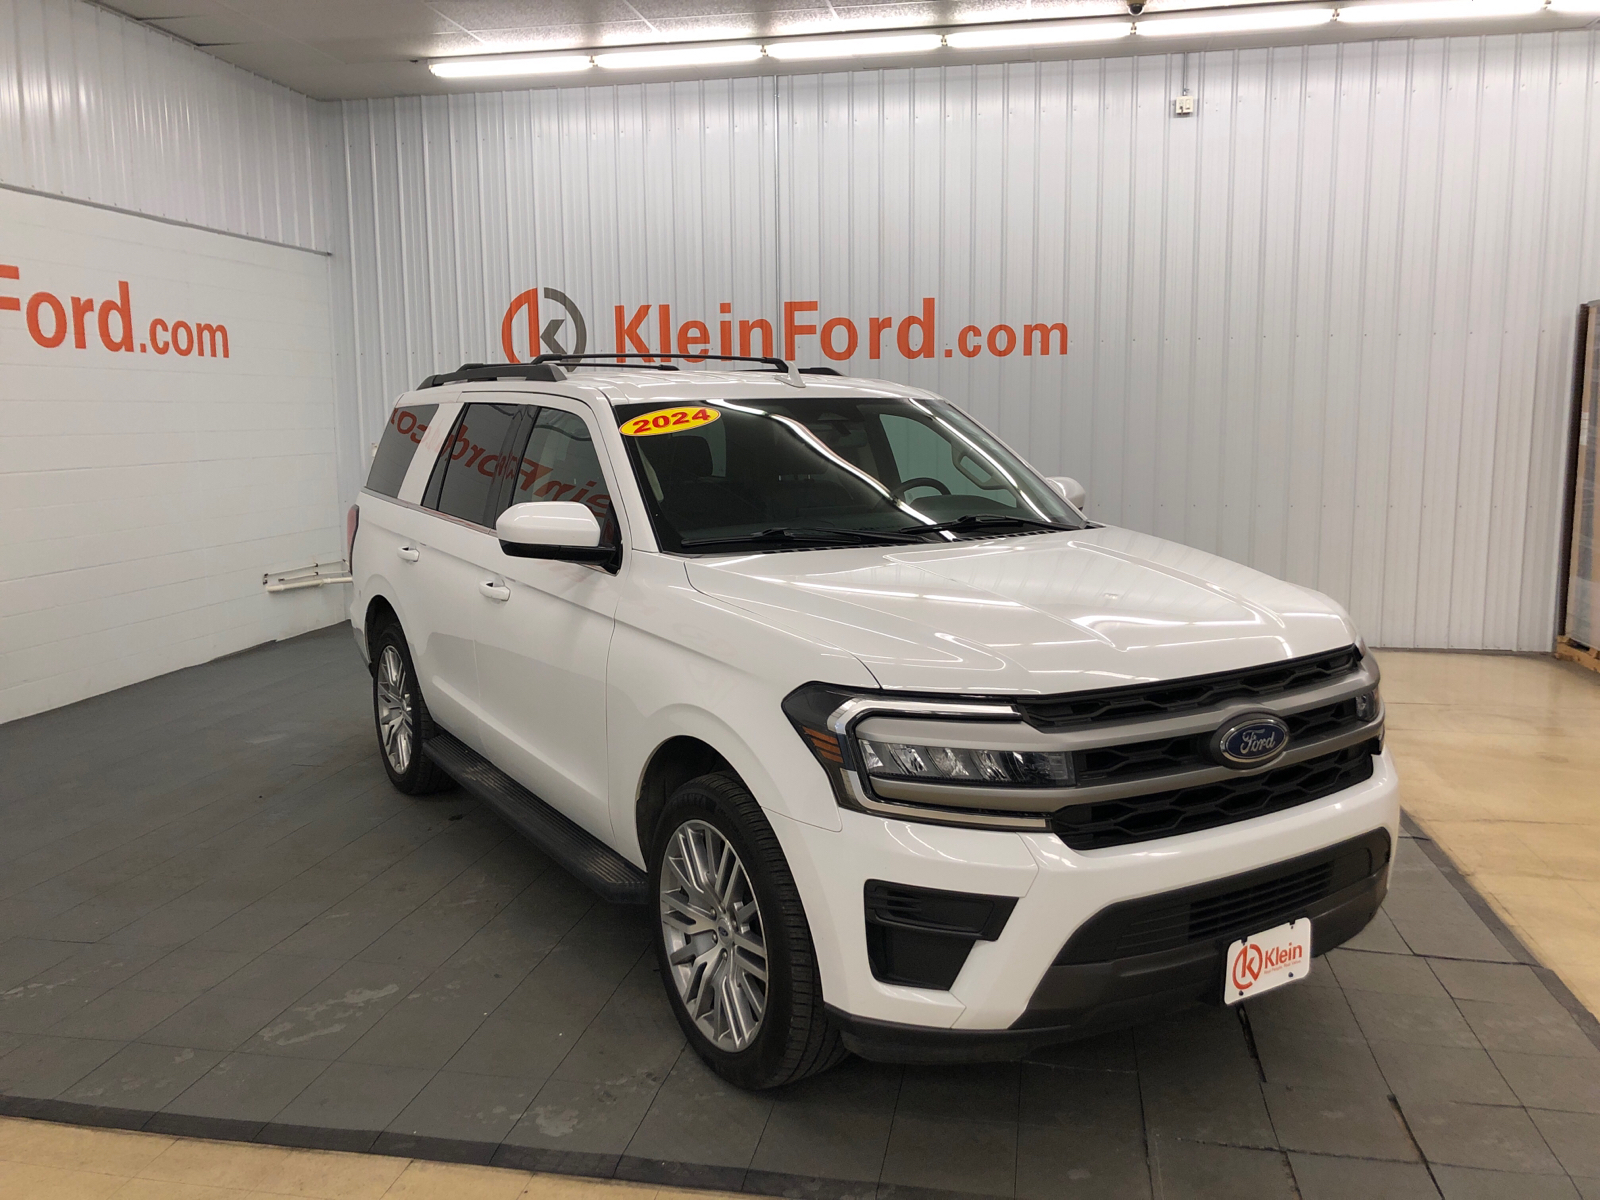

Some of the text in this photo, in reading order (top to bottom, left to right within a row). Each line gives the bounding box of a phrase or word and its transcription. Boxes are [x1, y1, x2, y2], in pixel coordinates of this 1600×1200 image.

[614, 297, 1068, 363] KleinFord.com
[632, 408, 711, 434] 2024
[1240, 728, 1275, 754] Ford
[1264, 942, 1303, 969] Klein
